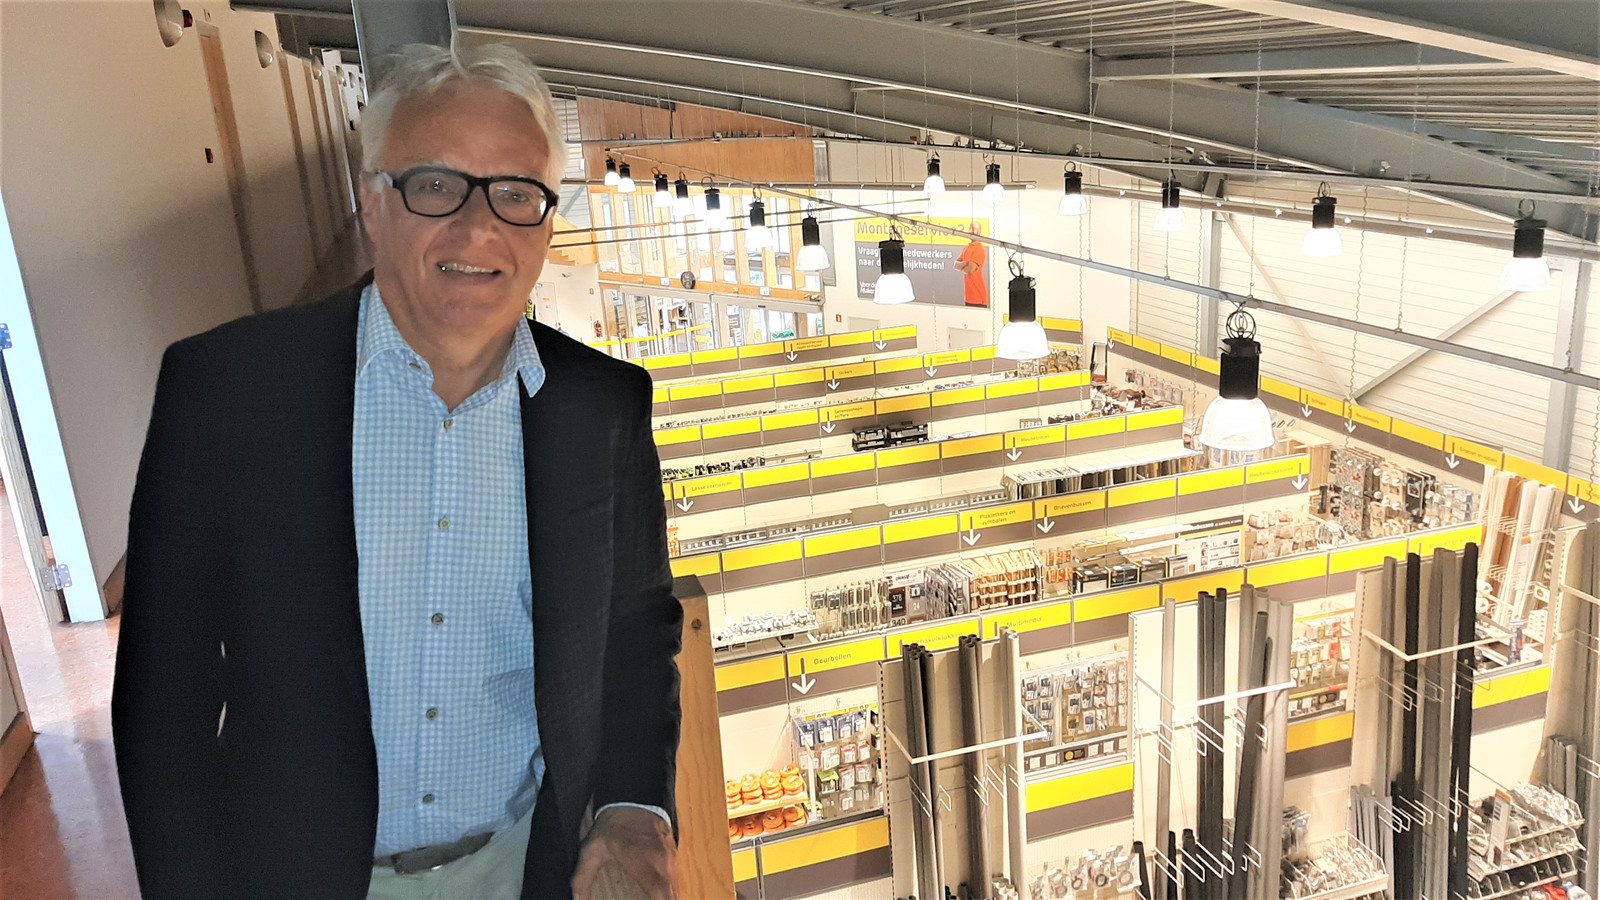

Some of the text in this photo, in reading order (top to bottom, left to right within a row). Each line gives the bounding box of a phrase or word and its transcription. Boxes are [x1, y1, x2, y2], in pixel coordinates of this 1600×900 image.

[857, 246, 880, 257] Vraag
[858, 258, 874, 266] naar
[903, 260, 945, 270] elijkheden!
[1006, 616, 1042, 628] Multimedia
[813, 653, 852, 665] Deurbellen
